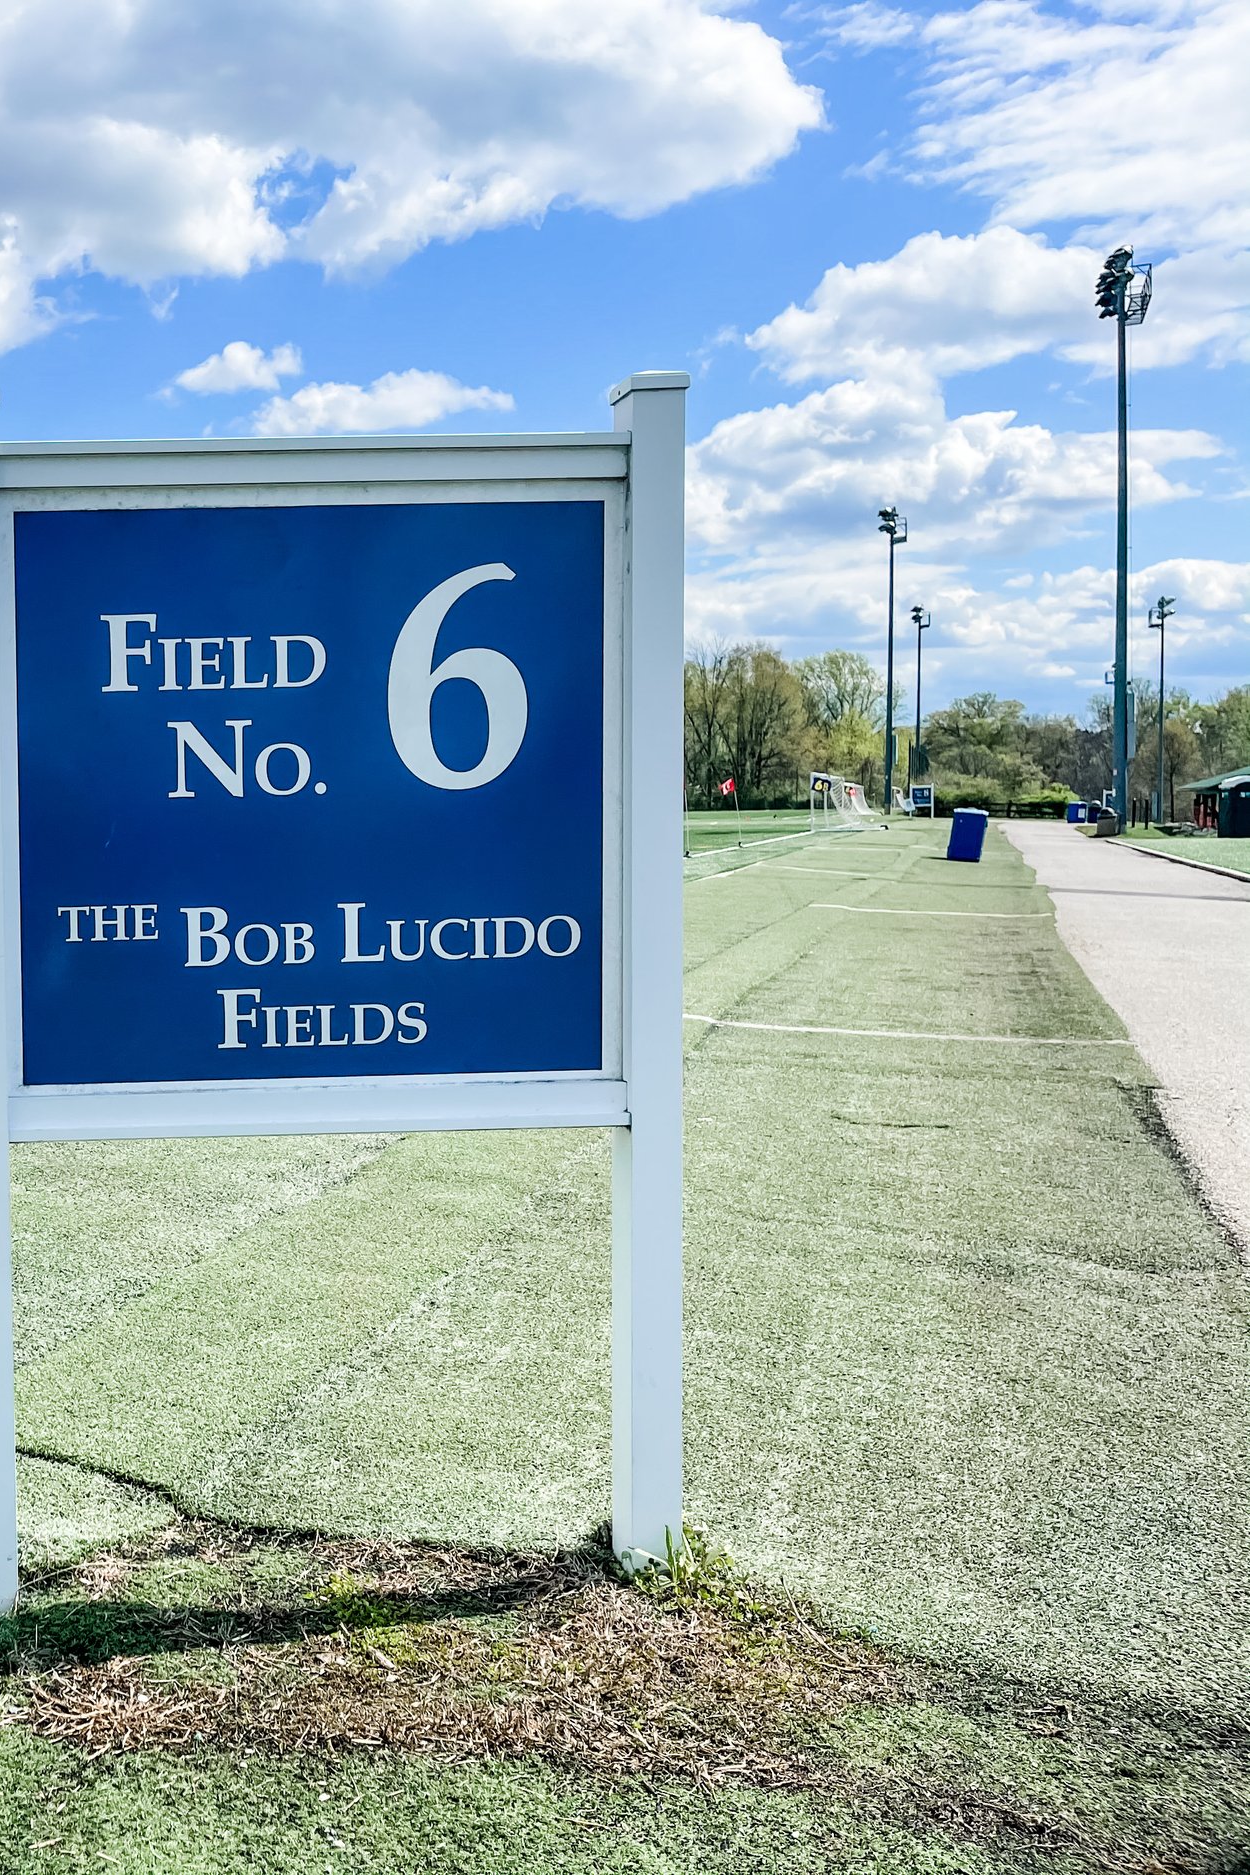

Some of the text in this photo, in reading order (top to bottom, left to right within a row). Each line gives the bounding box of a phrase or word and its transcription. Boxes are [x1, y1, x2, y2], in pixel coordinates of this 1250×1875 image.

[100, 613, 327, 692] FIELD
[388, 562, 528, 791] 6
[167, 719, 327, 798] NO.
[57, 902, 582, 968] THE BOB LUCIDO
[216, 988, 428, 1050] FIELDS
